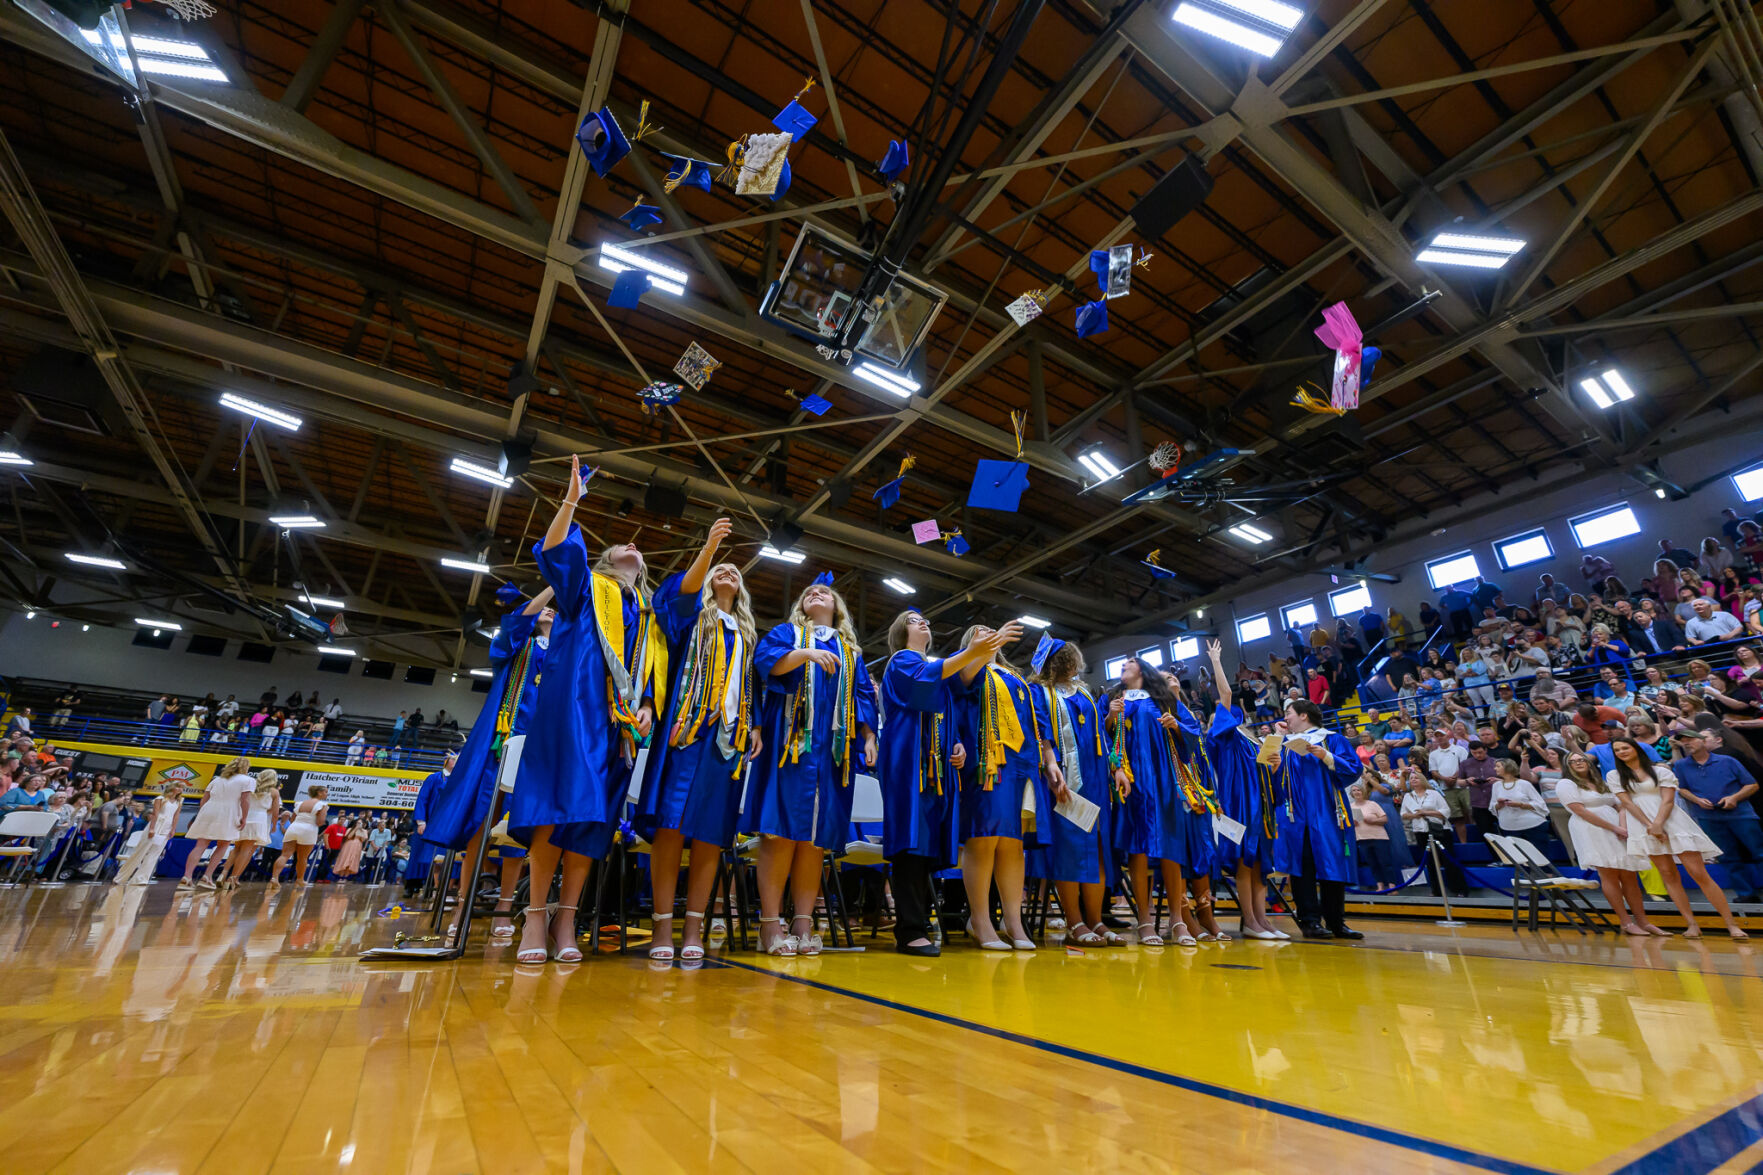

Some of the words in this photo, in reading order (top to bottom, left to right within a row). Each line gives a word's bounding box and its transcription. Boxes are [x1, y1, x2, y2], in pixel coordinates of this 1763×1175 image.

[54, 749, 82, 757] GUEST
[171, 769, 190, 778] PM
[306, 773, 378, 785] Hatcher-O'Briant
[327, 784, 354, 794] Family
